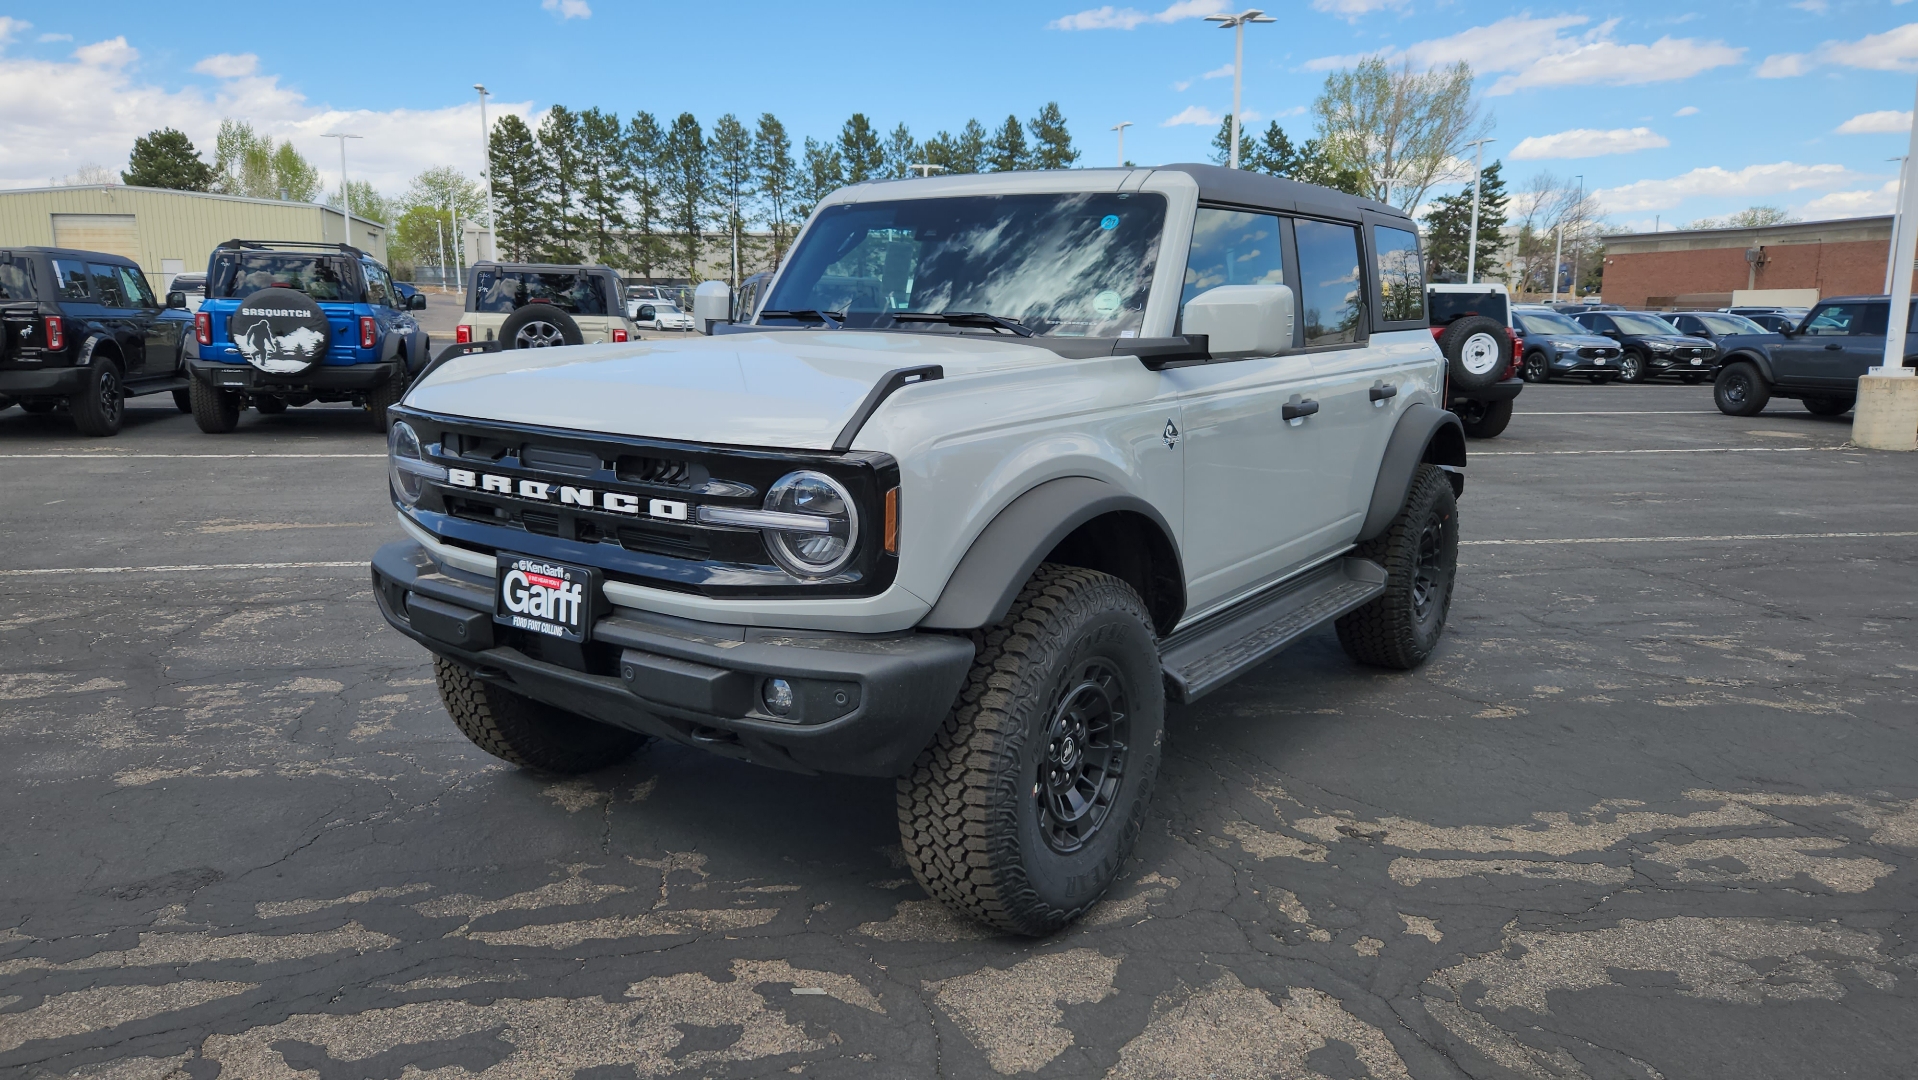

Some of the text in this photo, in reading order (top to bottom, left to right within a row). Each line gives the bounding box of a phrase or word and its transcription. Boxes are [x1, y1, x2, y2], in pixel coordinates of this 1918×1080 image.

[242, 308, 311, 318] SASQUATCH
[449, 468, 688, 521] BRONCO
[503, 570, 582, 626] Garff
[513, 616, 563, 637] FORD FORT COLLINS
